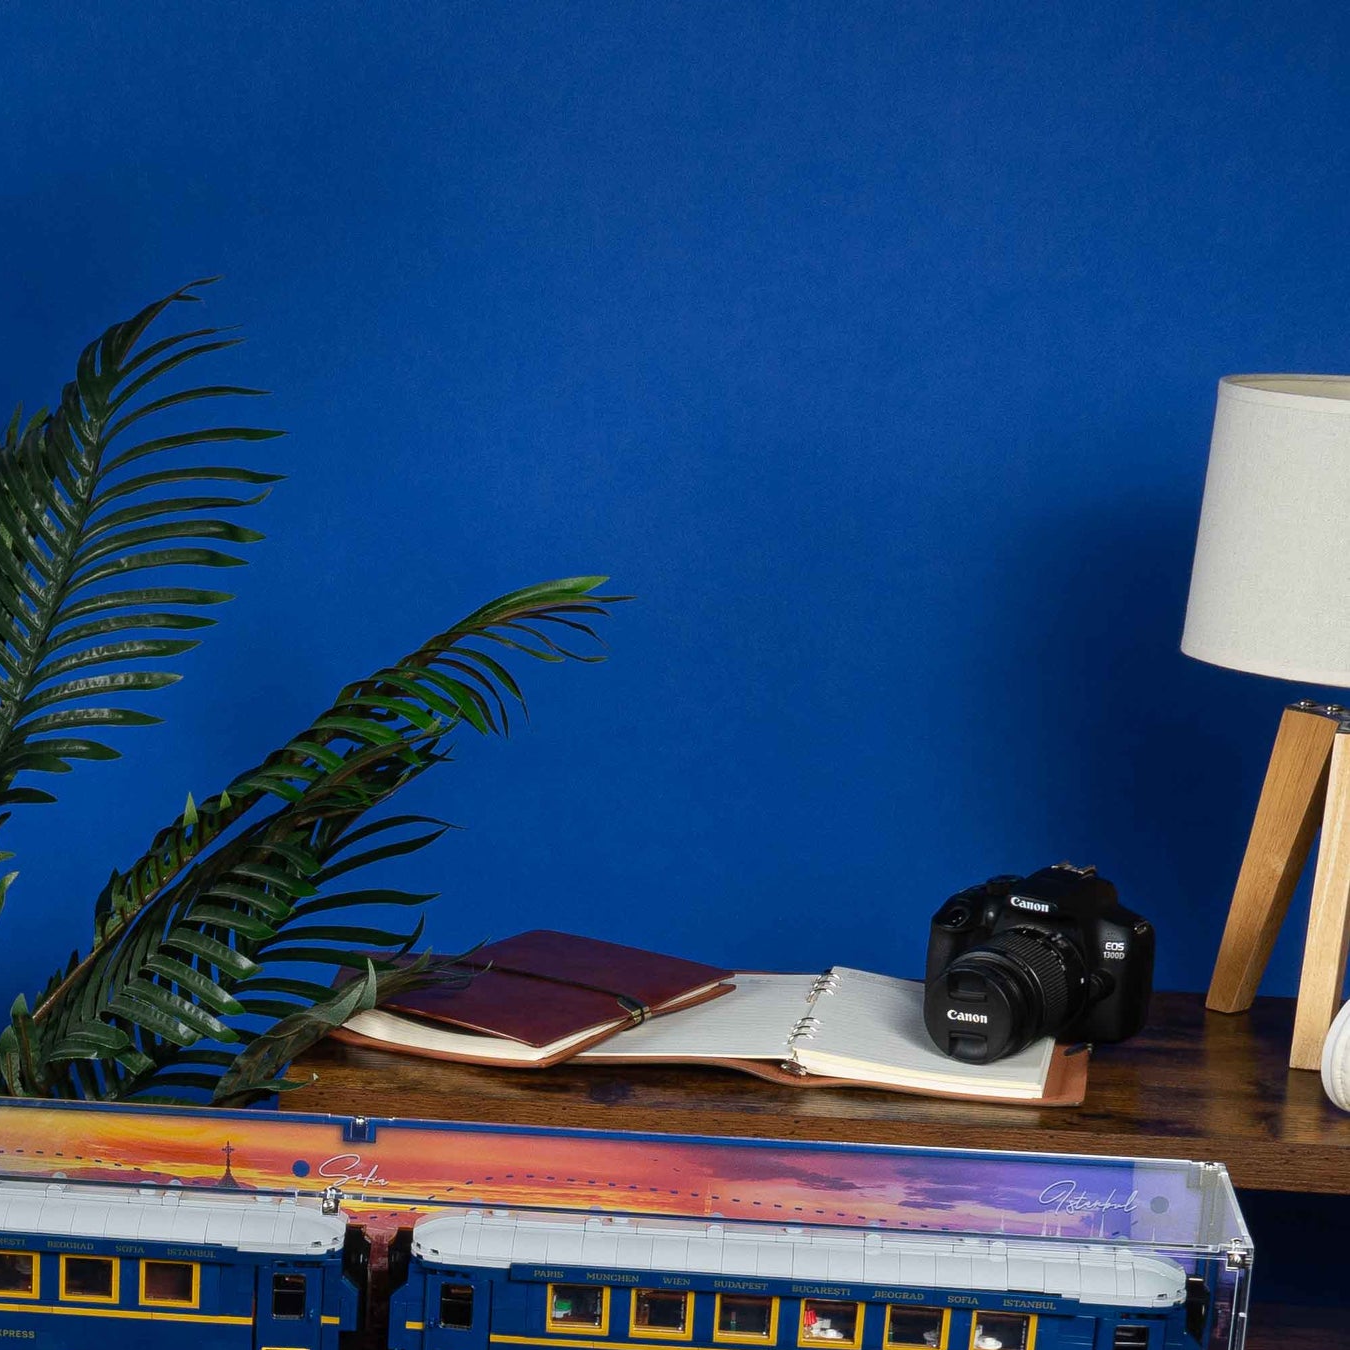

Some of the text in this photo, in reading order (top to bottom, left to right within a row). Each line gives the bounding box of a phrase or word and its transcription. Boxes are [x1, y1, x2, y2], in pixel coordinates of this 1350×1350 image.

[1010, 896, 1049, 913] Canon
[1105, 941, 1125, 951] EOS
[1103, 951, 1125, 960] 1300D
[947, 1009, 988, 1024] Canon
[319, 1153, 389, 1187] Sofia
[1039, 1180, 1138, 1215] Istanbul
[115, 1245, 145, 1254] SOFIA
[166, 1248, 217, 1259] ISTANBUL
[533, 1270, 564, 1279] PARIS
[662, 1276, 690, 1286] WIEN
[713, 1280, 769, 1290] BUDAPEST
[874, 1290, 924, 1301] BEOGRAD
[947, 1295, 978, 1305] SOFIA
[1003, 1299, 1057, 1310] ISTANBUL
